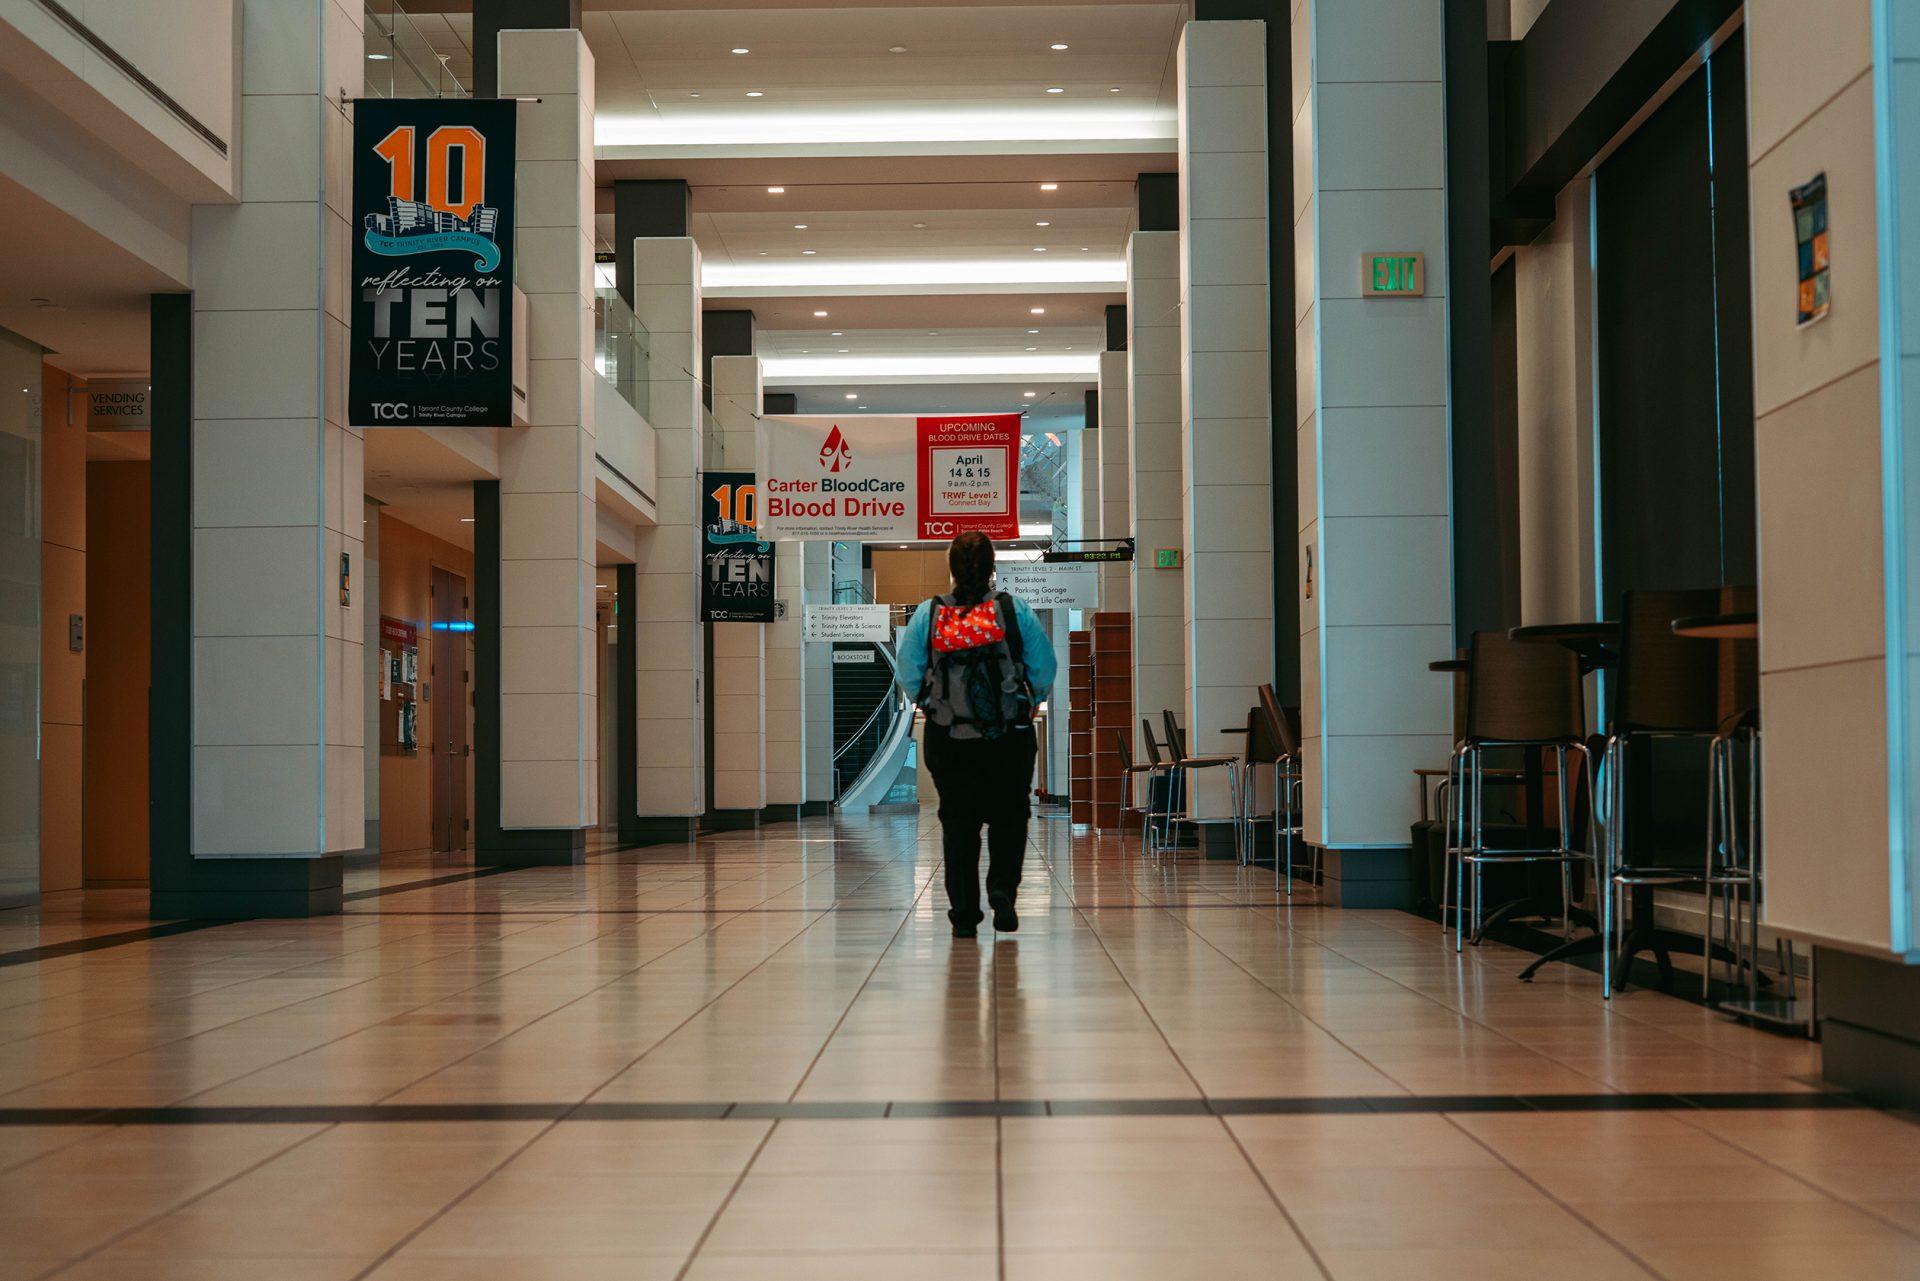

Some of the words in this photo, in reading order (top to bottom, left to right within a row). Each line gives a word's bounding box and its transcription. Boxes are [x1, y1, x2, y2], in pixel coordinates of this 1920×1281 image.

[372, 125, 486, 222] 10
[1373, 257, 1416, 291] EXIT
[361, 266, 470, 297] reflecting
[475, 275, 502, 287] on
[362, 288, 500, 338] TEN
[368, 340, 499, 371] YEARS
[91, 393, 145, 403] VENDING
[94, 405, 144, 416] SERVICES
[371, 402, 409, 420] TCC
[440, 405, 463, 413] County
[464, 405, 489, 413] College
[939, 422, 996, 433] UPCOMING
[928, 434, 956, 442] BLOOD
[983, 433, 1010, 441] DATES
[955, 455, 983, 467] April
[949, 467, 963, 478] 14
[965, 467, 974, 478] &
[977, 467, 991, 478] 15
[767, 478, 818, 493] Carter
[821, 478, 905, 493] BloodCare
[941, 491, 967, 500] TRWF
[969, 491, 991, 500] Level
[993, 491, 998, 499] 2
[711, 484, 757, 529] 10
[768, 497, 836, 517] Blood
[844, 497, 905, 517] Drive
[948, 499, 977, 507] Connect
[978, 499, 992, 507] Bay
[924, 522, 954, 535] TCC
[706, 548, 756, 563] reflecting
[1157, 550, 1178, 567] EXIT
[706, 558, 770, 582] TEN
[1014, 576, 1047, 584] Bookstore
[709, 582, 770, 597] YEARS
[1015, 587, 1040, 595] Parking
[1041, 586, 1067, 595] Garage
[710, 610, 729, 619] TCC
